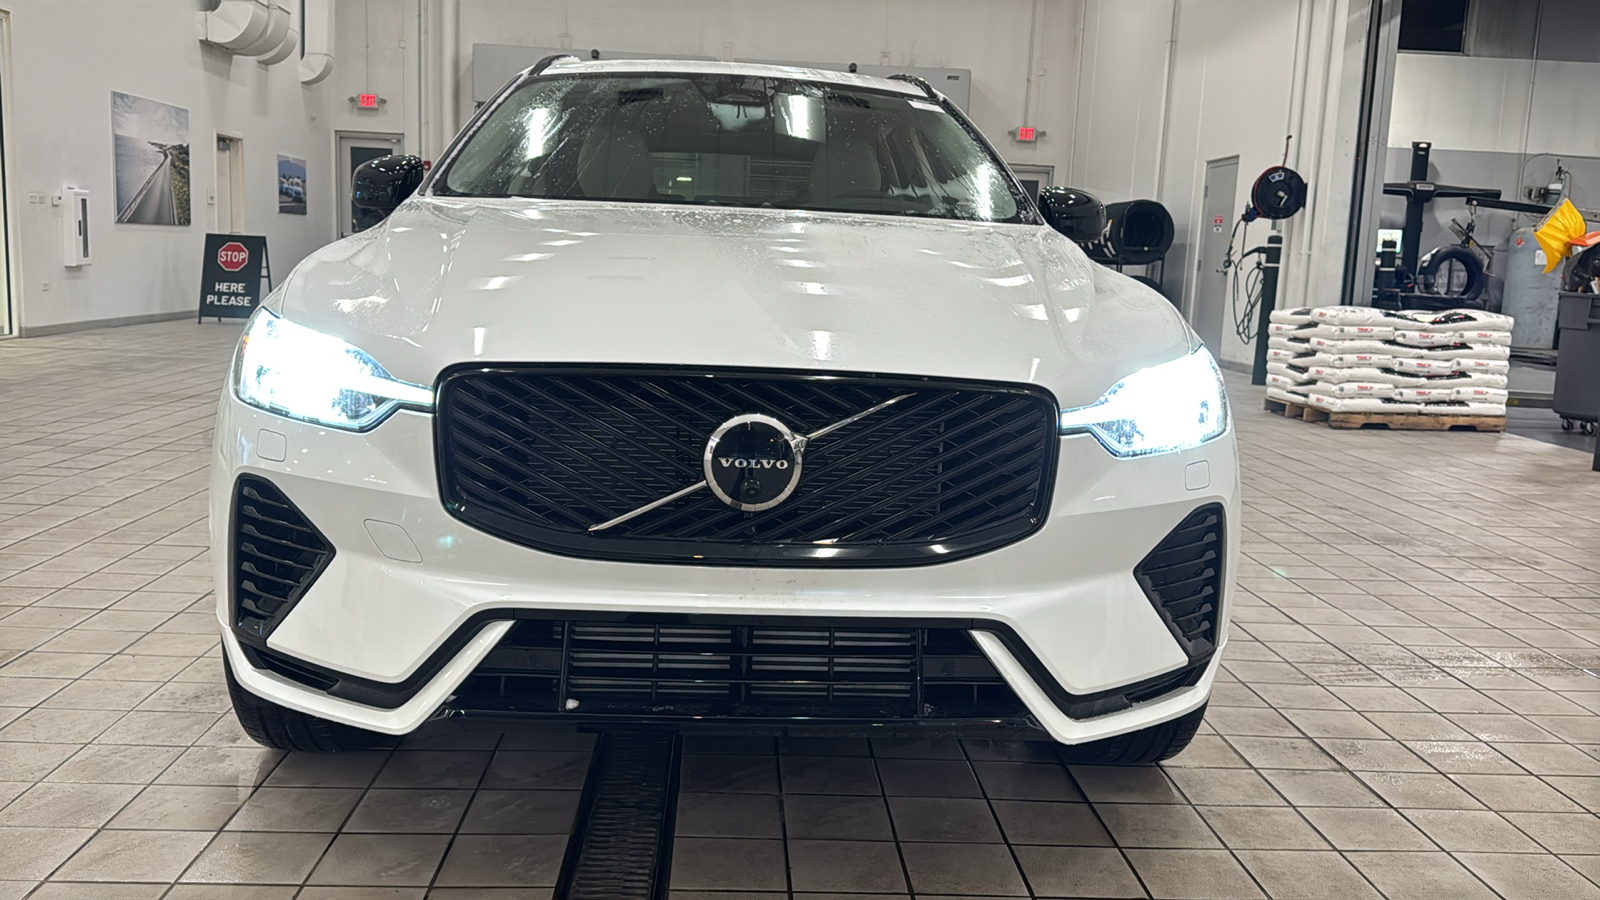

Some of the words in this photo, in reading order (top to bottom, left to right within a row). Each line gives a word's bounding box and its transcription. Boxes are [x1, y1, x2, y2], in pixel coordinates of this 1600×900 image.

[220, 251, 246, 262] STOP
[215, 282, 246, 293] HERE
[206, 295, 252, 306] PLEASE
[718, 457, 789, 470] VOLVO
